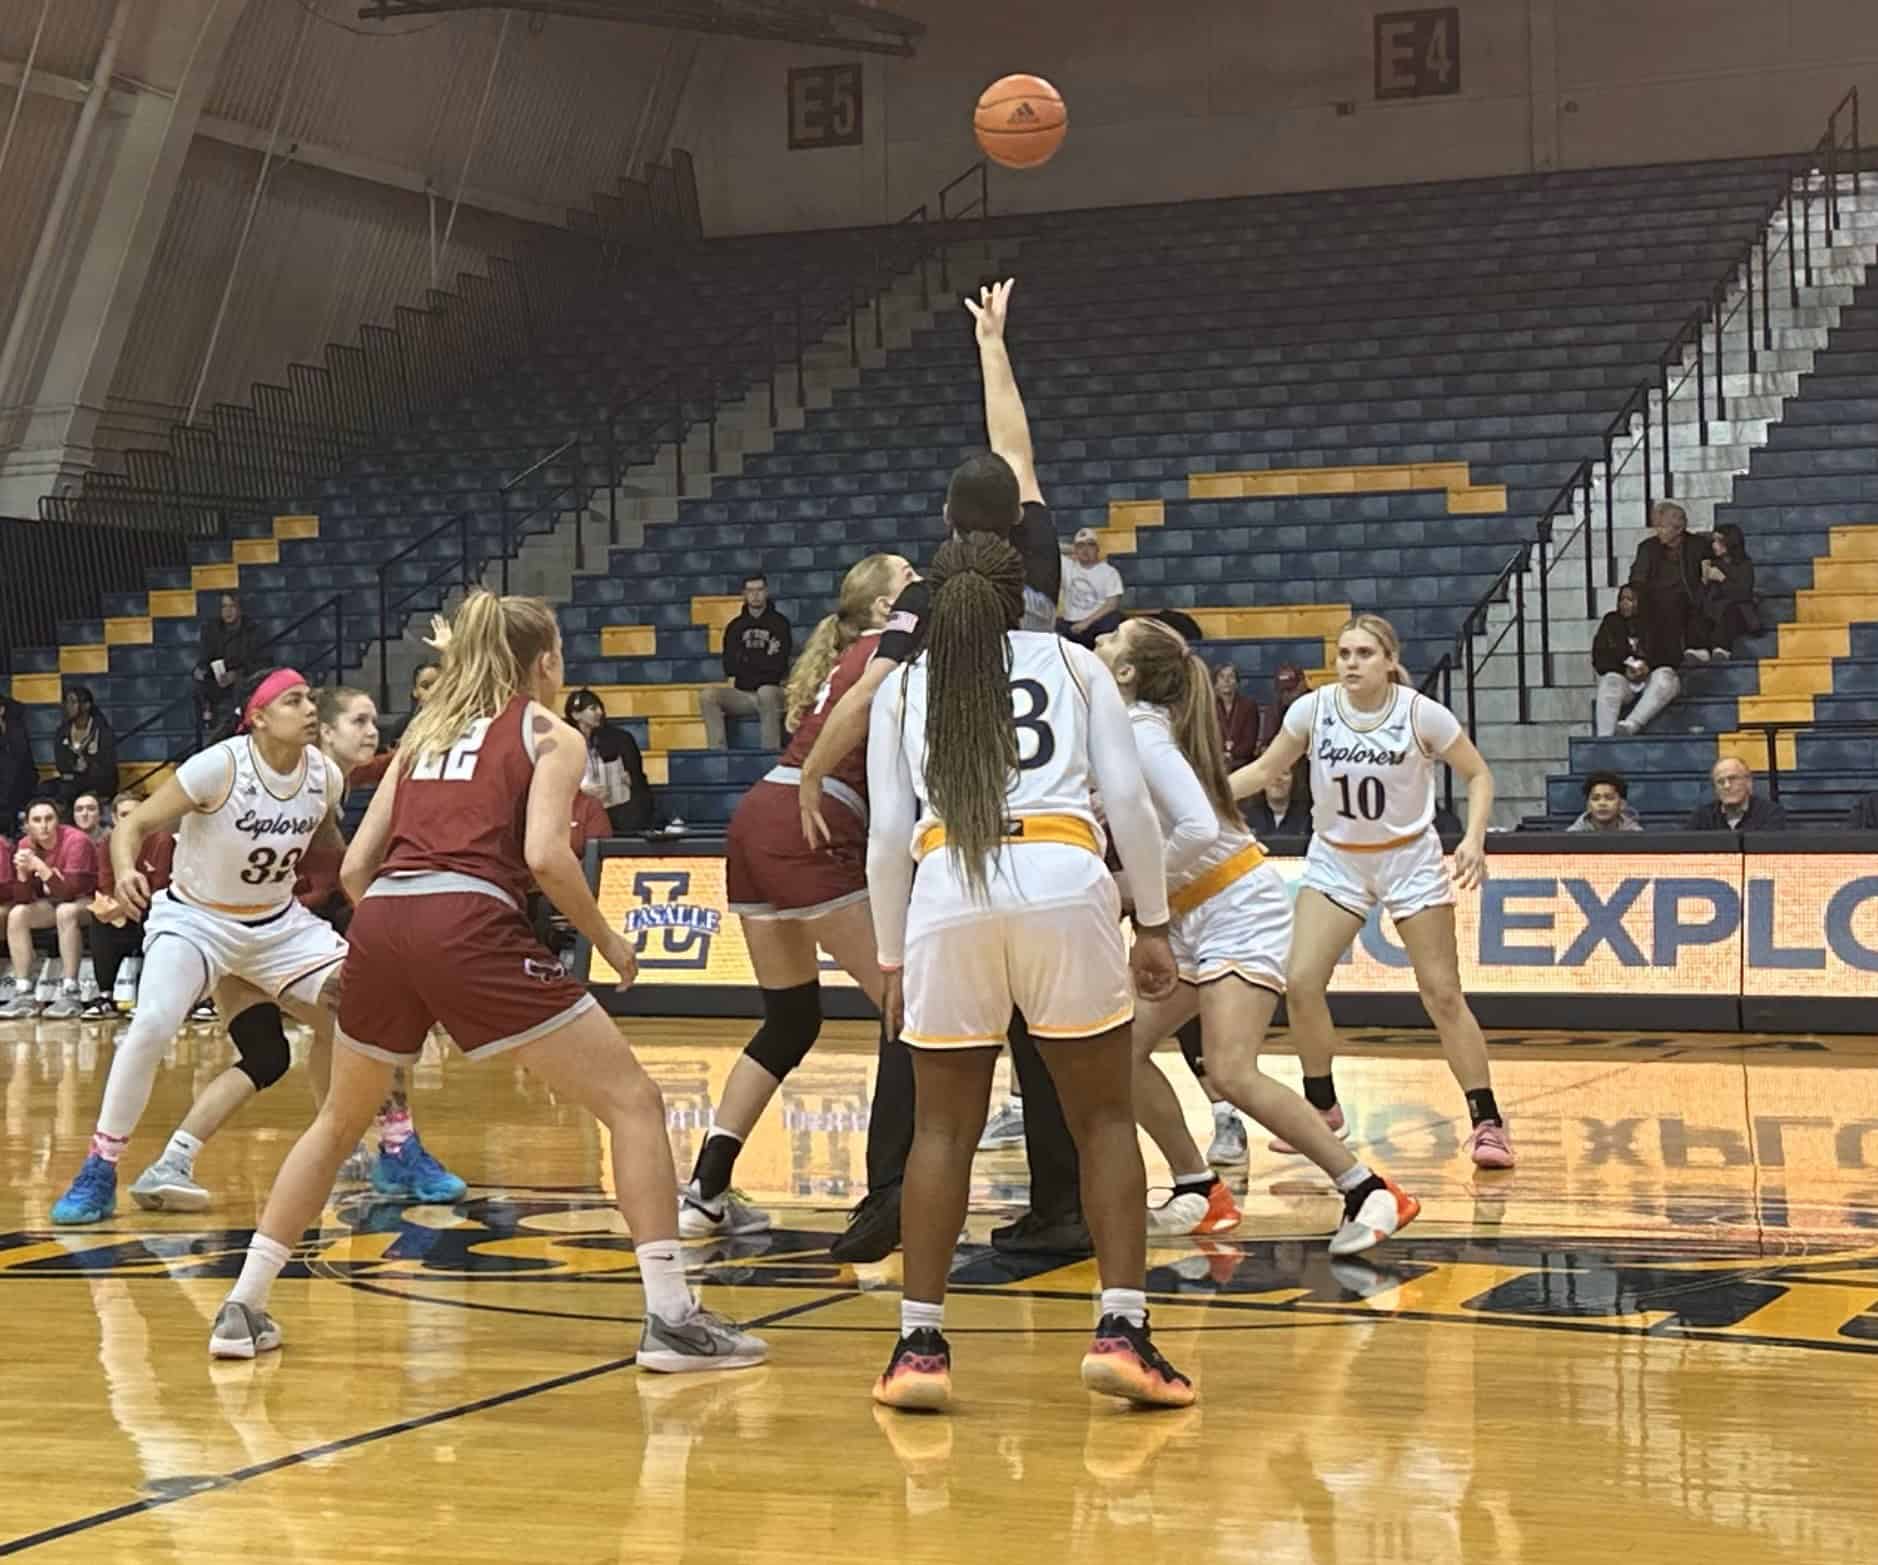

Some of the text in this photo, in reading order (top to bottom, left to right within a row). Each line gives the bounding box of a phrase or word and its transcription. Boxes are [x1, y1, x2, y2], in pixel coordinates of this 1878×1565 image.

[1380, 17, 1453, 88] E4
[792, 71, 857, 140] E5
[1332, 773, 1386, 821] 10
[1477, 875, 1878, 971] EXPLO
